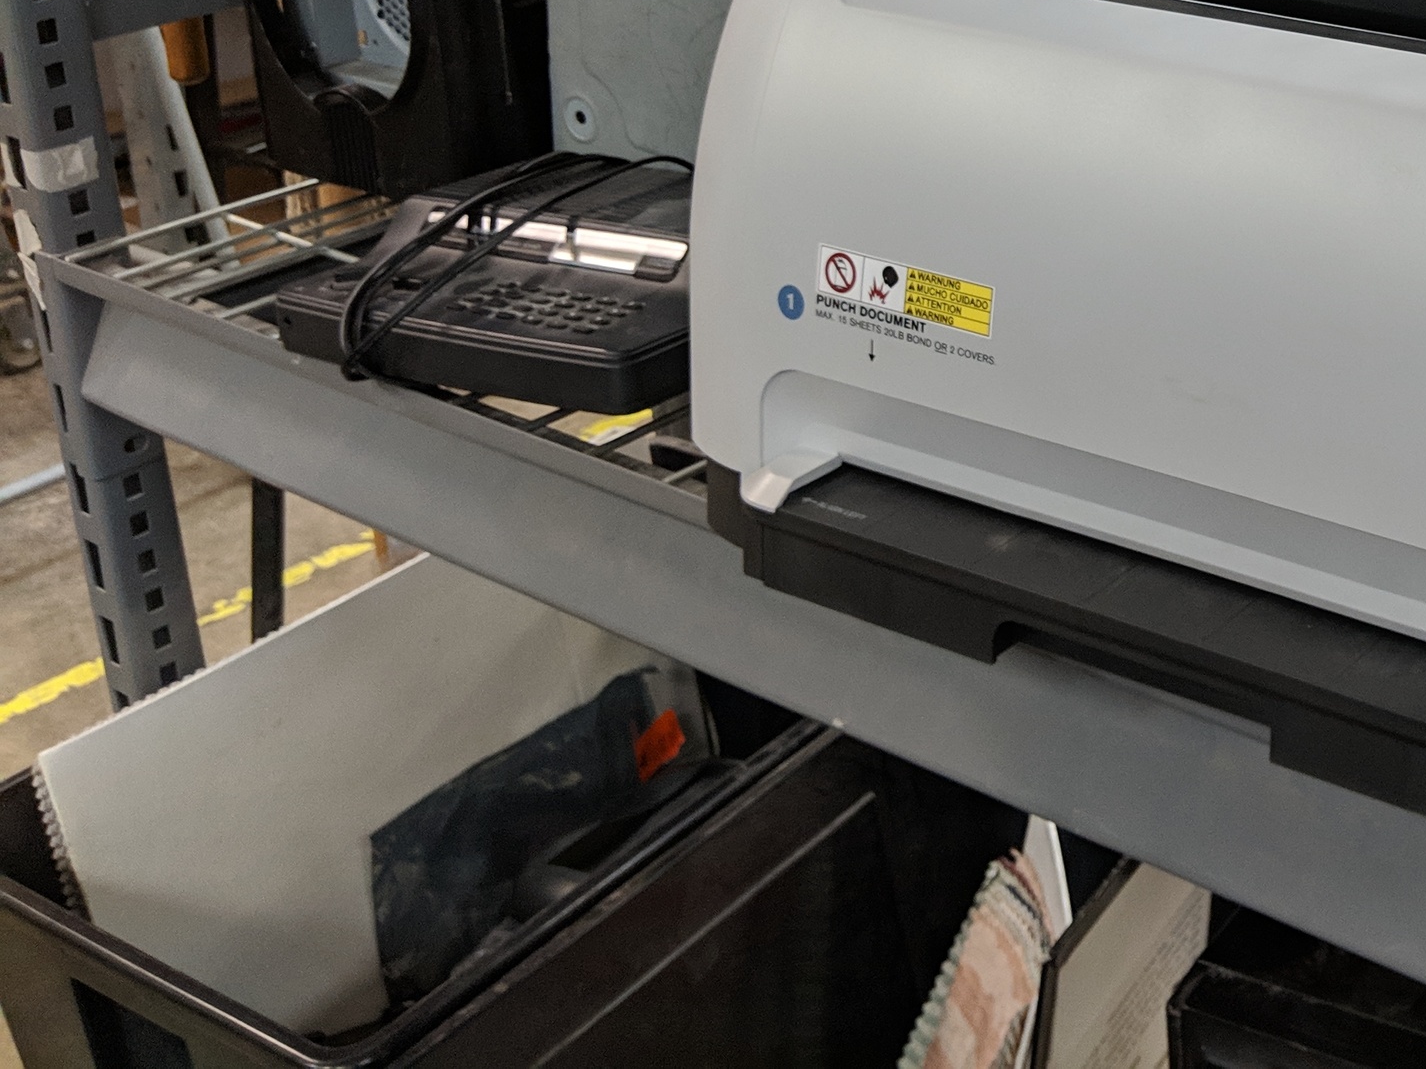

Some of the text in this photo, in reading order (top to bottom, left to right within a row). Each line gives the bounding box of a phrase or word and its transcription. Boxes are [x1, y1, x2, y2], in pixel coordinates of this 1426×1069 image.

[918, 272, 961, 290] WARNUNG
[916, 284, 988, 310] MUCHO CUIDADO
[916, 296, 962, 316] ATTENTION
[786, 292, 926, 333] 1 PUNCH DOCUMENT
[914, 307, 954, 326] WARNING
[838, 316, 848, 324] 15
[850, 318, 882, 334] SHEETS
[884, 328, 904, 340] 20LB
[906, 333, 932, 348] BOND
[934, 340, 948, 352] OR
[950, 345, 955, 354] 2
